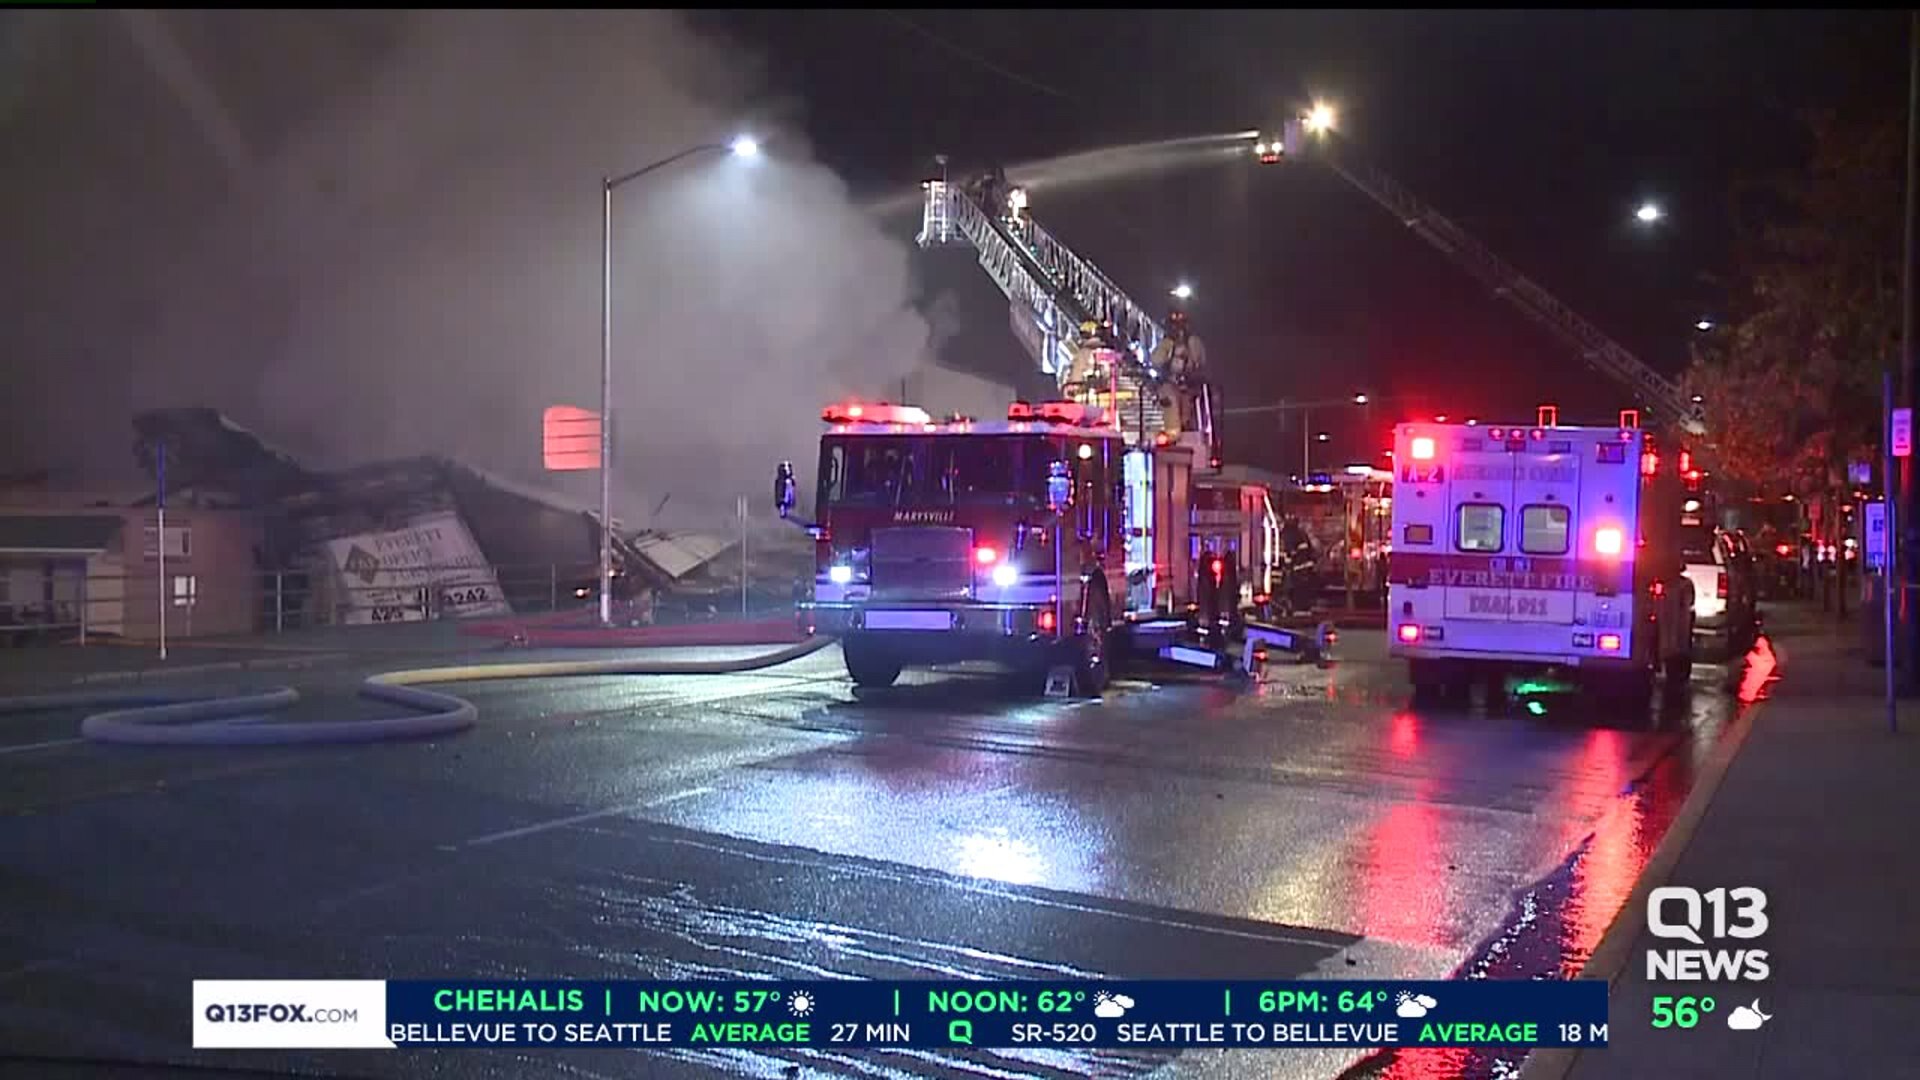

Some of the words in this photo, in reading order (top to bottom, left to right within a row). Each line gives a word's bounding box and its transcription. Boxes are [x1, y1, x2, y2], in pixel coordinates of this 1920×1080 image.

[893, 510, 954, 522] MARYSVILLE
[1429, 567, 1533, 588] EVERETT
[1540, 573, 1595, 591] FIRE
[1468, 593, 1515, 614] DIAL
[1517, 596, 1549, 617] 911
